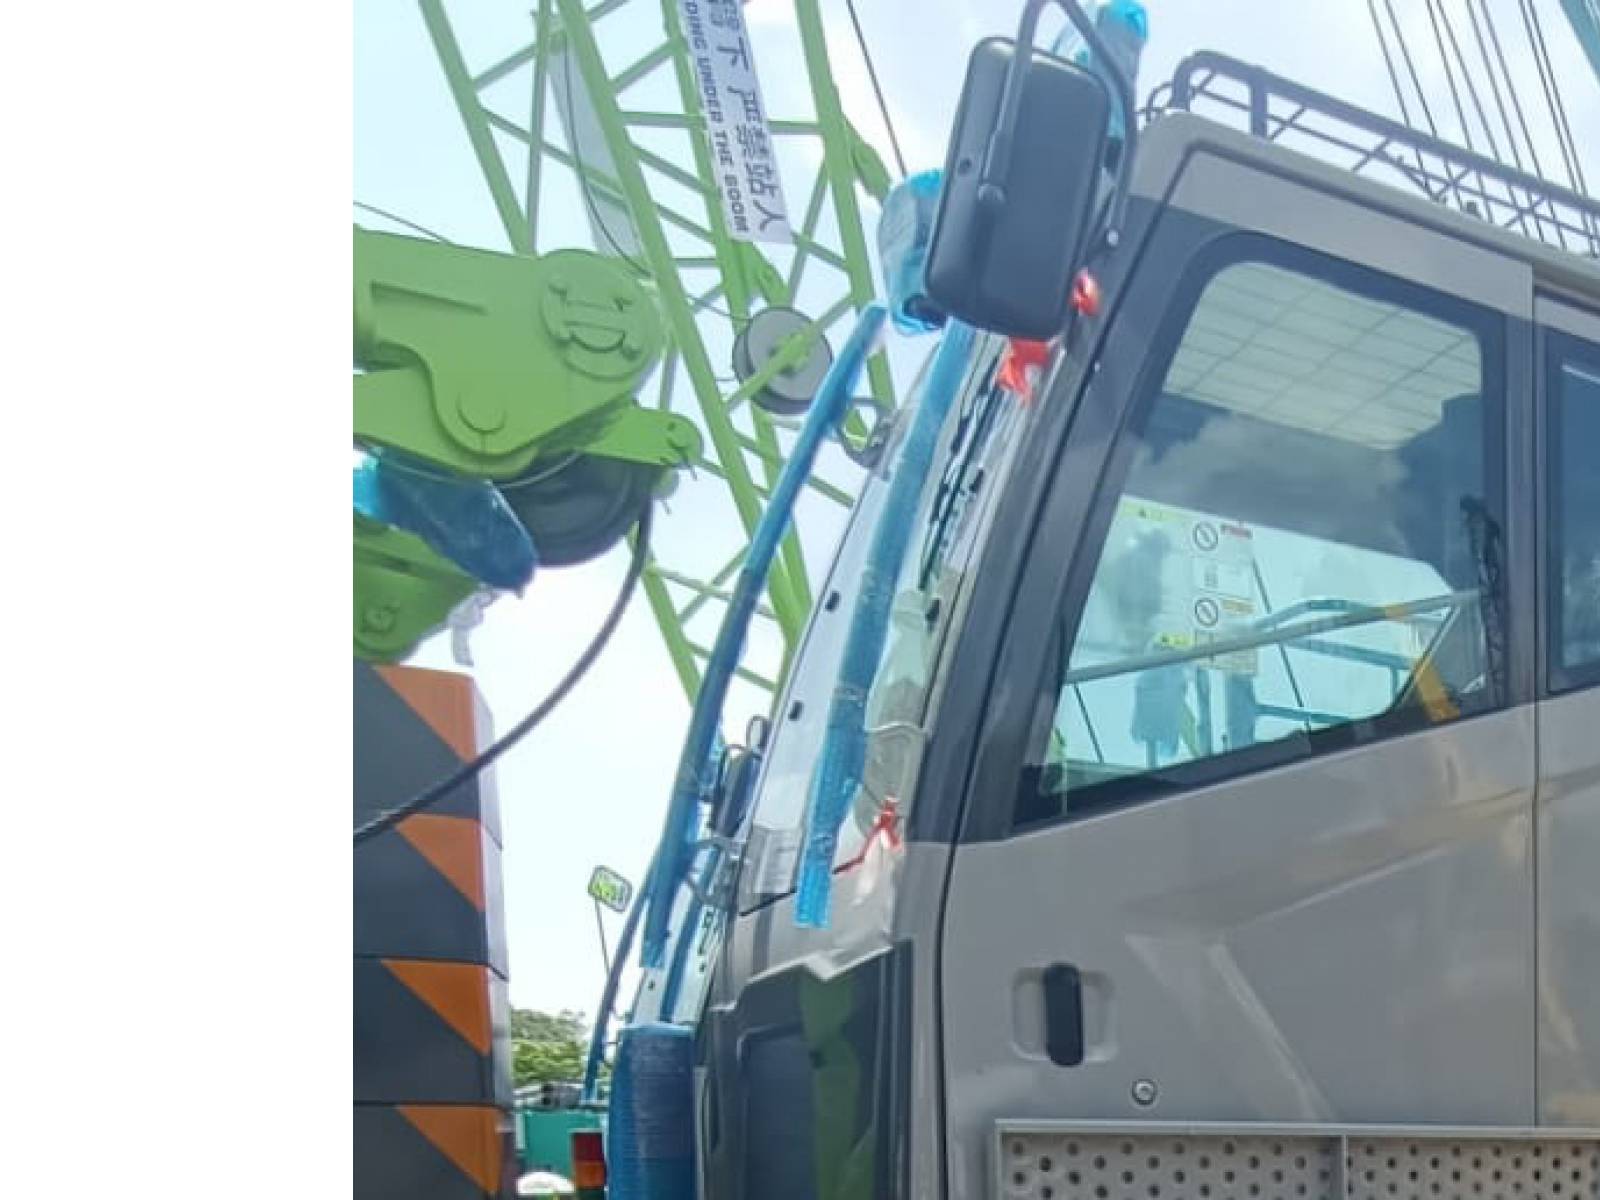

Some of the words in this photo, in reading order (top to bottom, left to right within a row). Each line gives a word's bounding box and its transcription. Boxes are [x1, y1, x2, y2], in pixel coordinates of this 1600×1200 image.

[697, 57, 723, 123] UNDER
[715, 130, 734, 166] THE
[724, 174, 748, 231] BOOM
